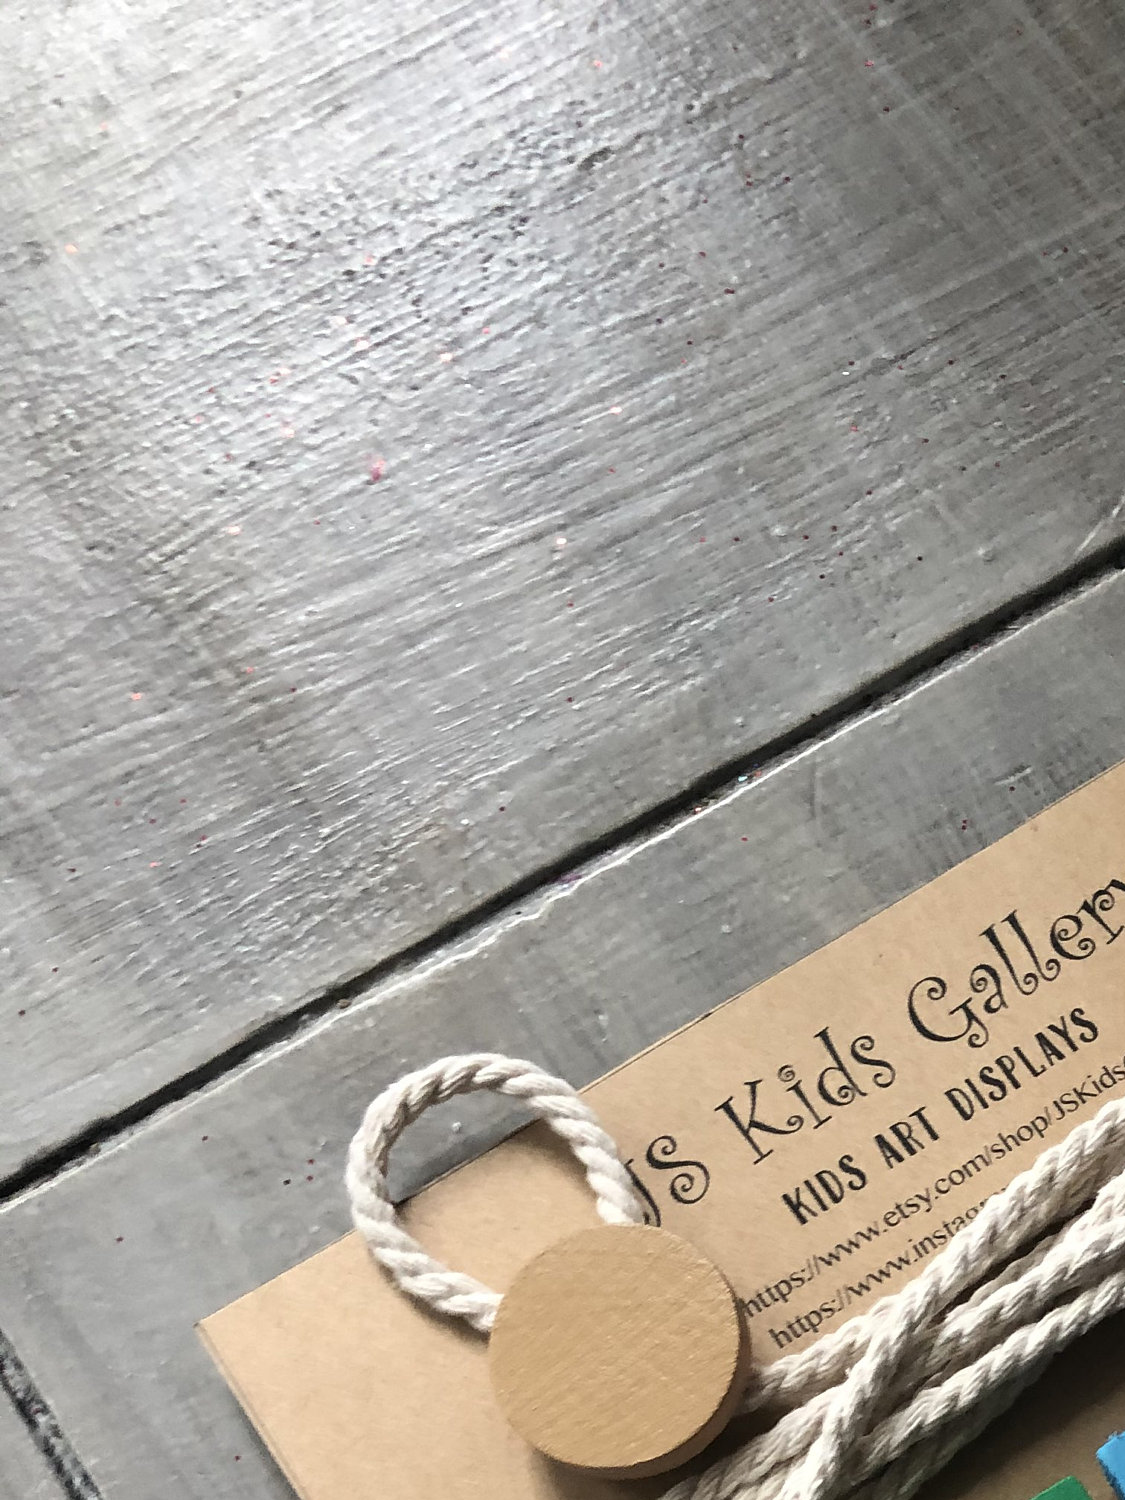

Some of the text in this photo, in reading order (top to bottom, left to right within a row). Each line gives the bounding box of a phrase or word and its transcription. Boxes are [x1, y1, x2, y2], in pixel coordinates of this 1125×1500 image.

[624, 1134, 711, 1228] JS
[714, 1026, 897, 1166] Kids
[780, 1007, 1099, 1226] KIDS ART DISPLAYS
